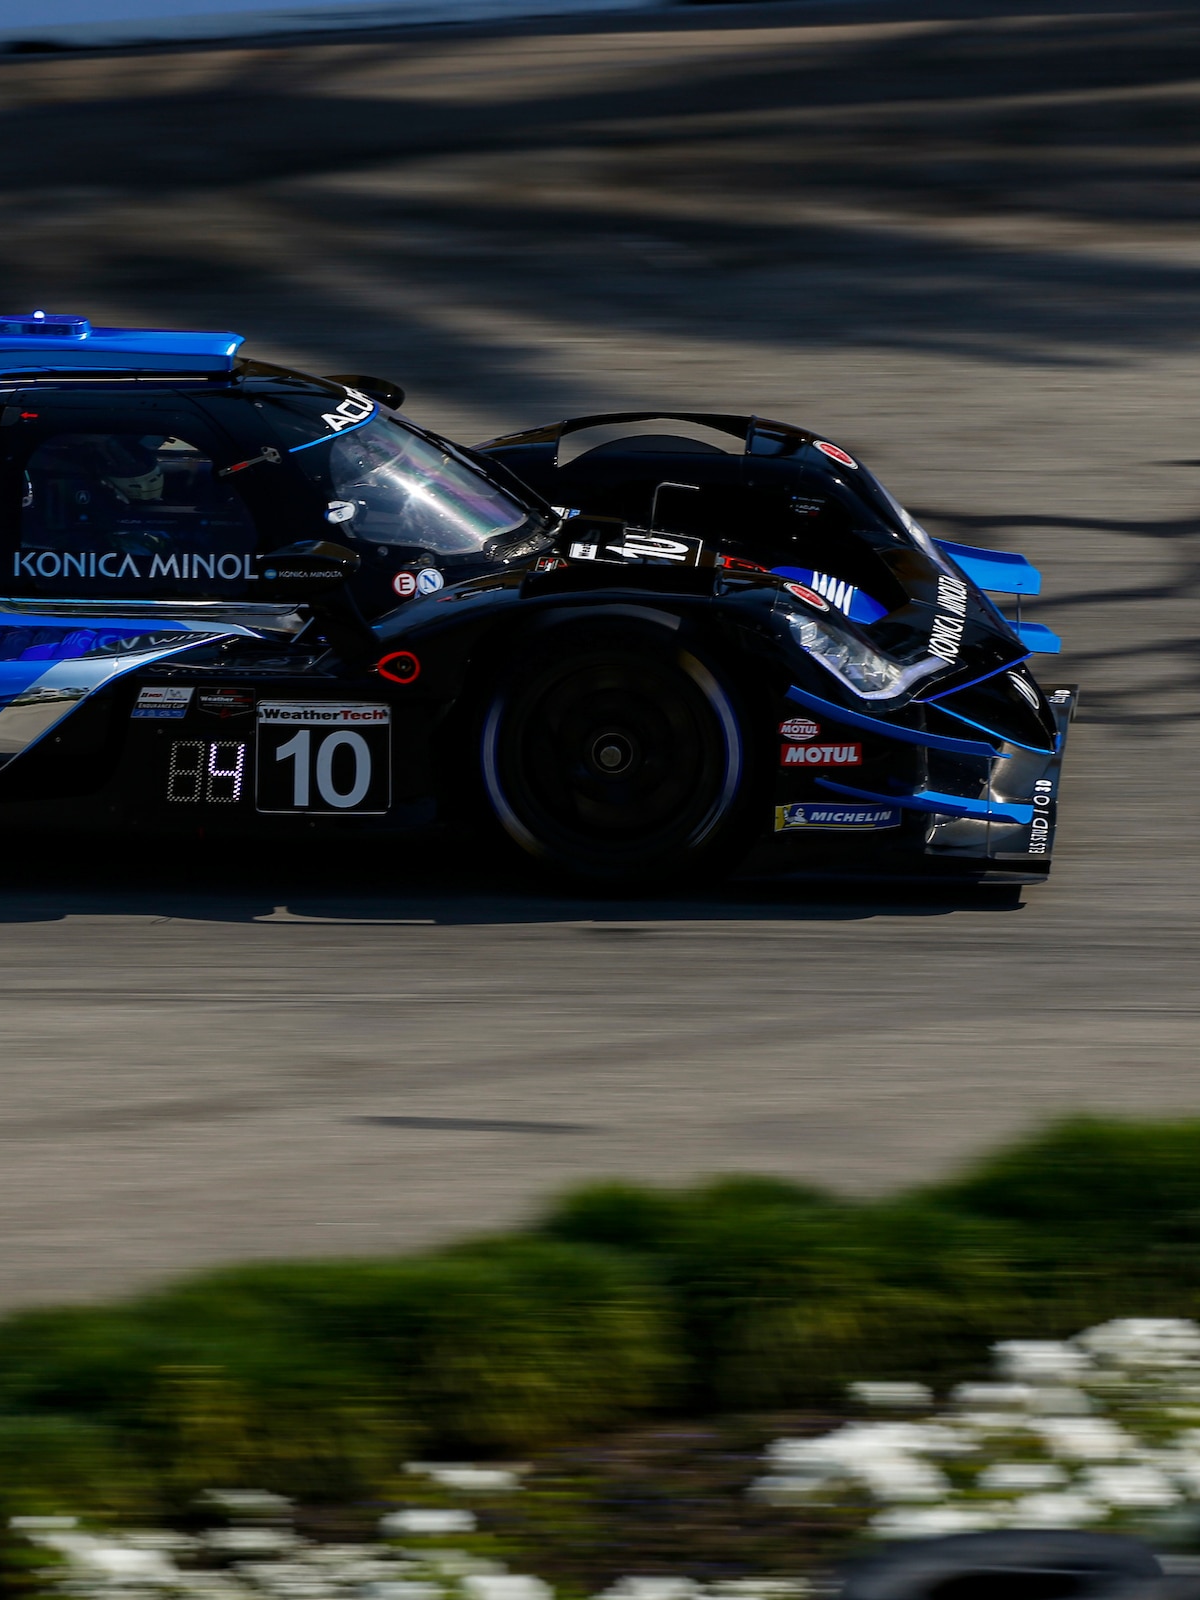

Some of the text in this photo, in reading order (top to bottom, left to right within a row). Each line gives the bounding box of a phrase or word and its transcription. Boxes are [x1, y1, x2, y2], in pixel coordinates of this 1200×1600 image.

[13, 551, 264, 580] KONICA MINOL
[927, 614, 965, 665] KONICA
[263, 709, 384, 720] WeatherTech
[781, 725, 819, 734] MOTUL
[784, 746, 859, 763] MOTUL
[275, 729, 372, 808] 10
[1035, 780, 1052, 792] 3D
[810, 811, 892, 822] MICHELIN
